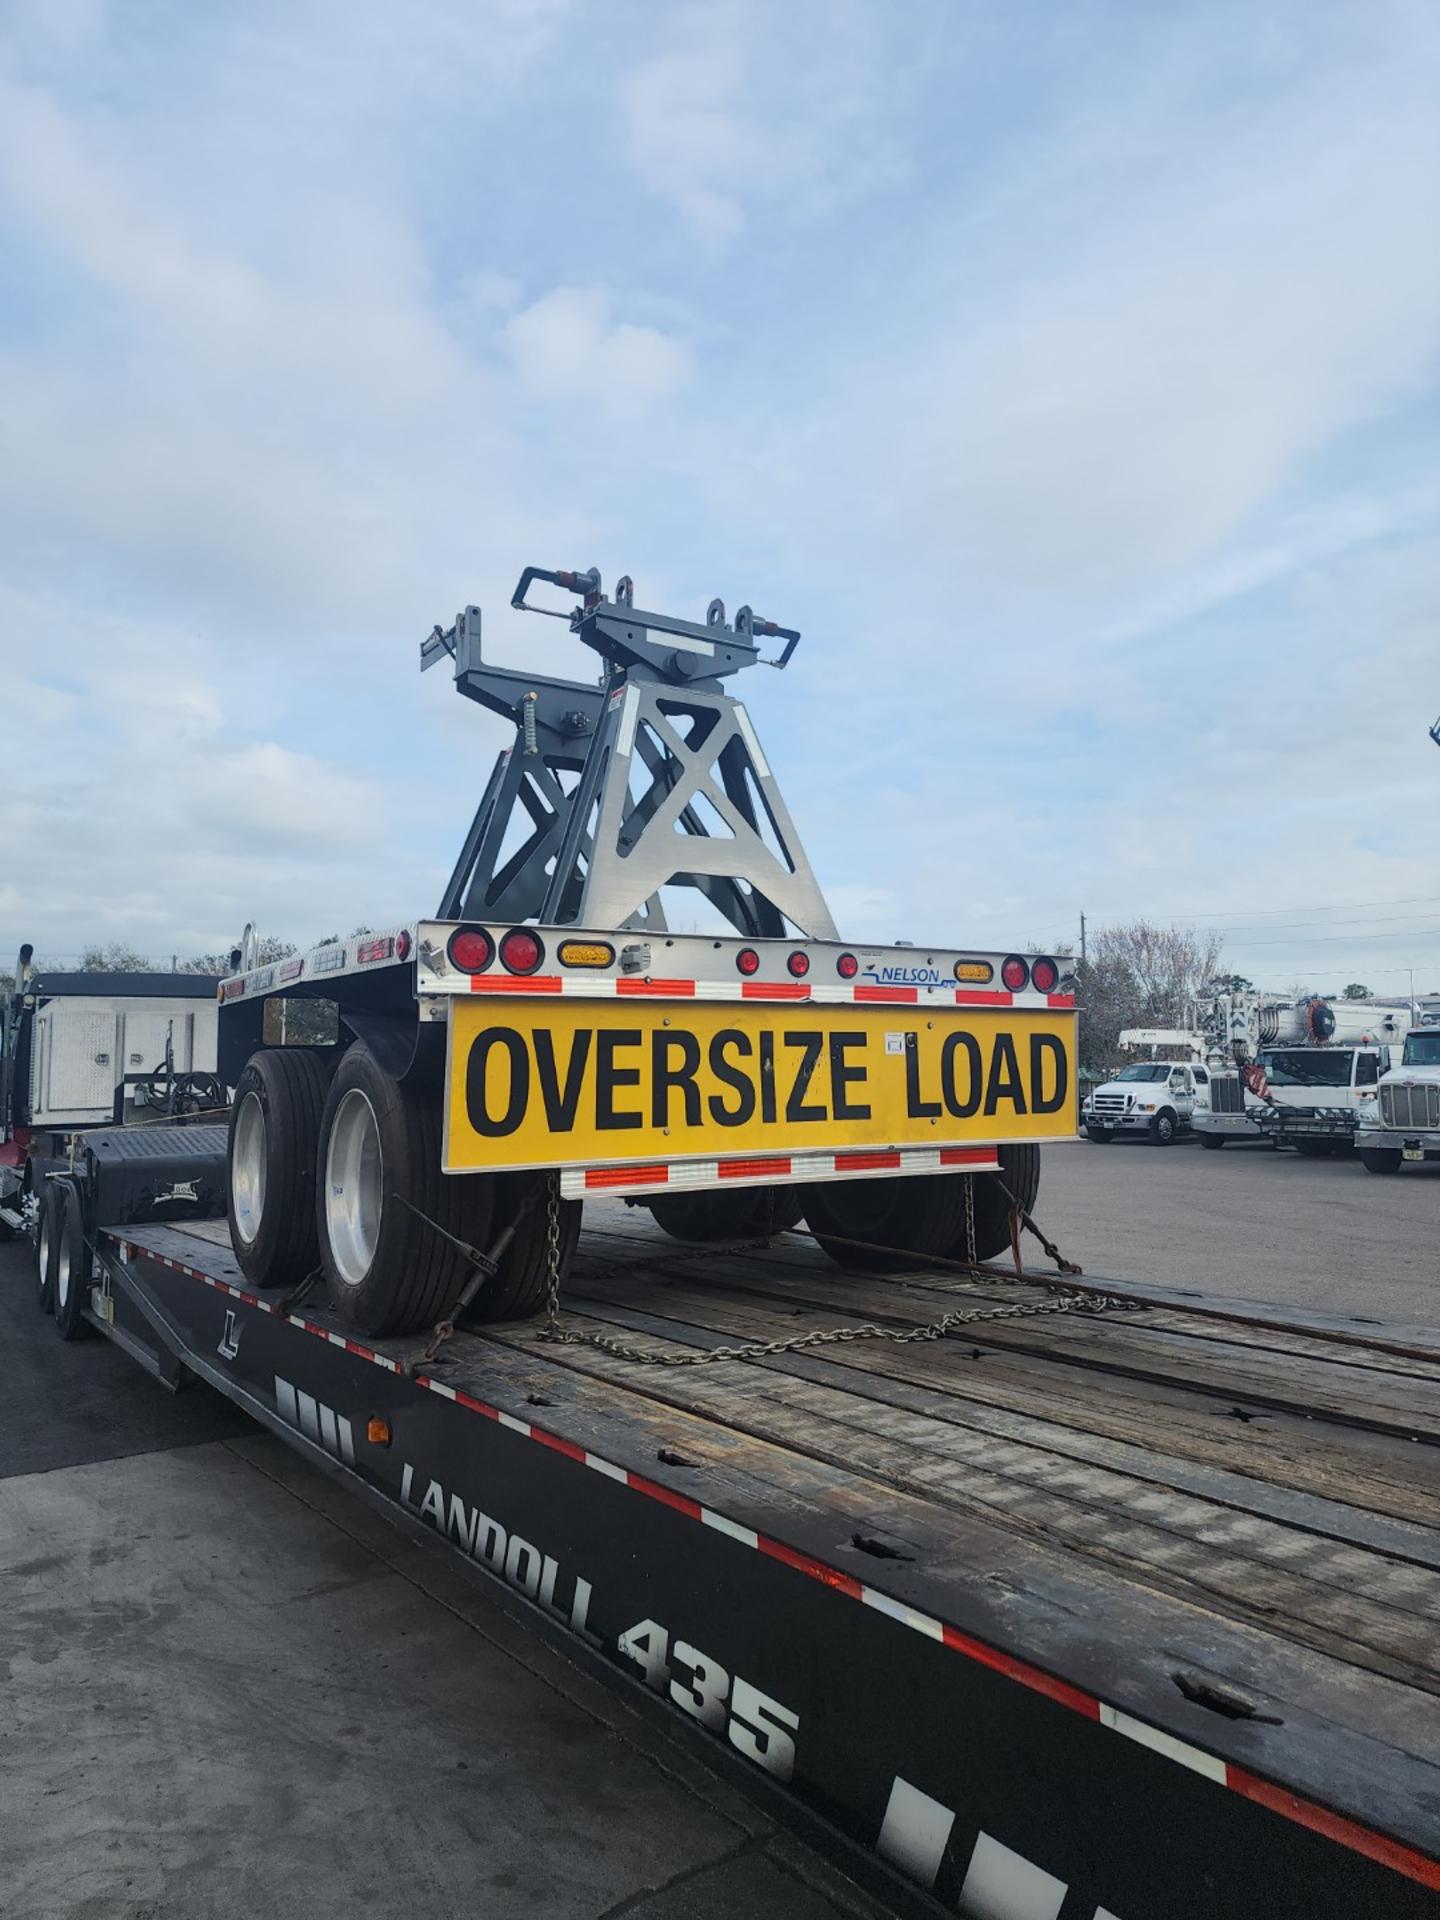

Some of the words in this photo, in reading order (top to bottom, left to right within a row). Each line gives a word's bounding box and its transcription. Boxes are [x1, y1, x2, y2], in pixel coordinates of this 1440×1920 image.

[881, 967, 940, 983] NELSON
[465, 1026, 872, 1138] OVERSIZE
[905, 1031, 1068, 1119] LOAD
[401, 1463, 604, 1645] LANDOLL
[617, 1618, 800, 1783] 435
